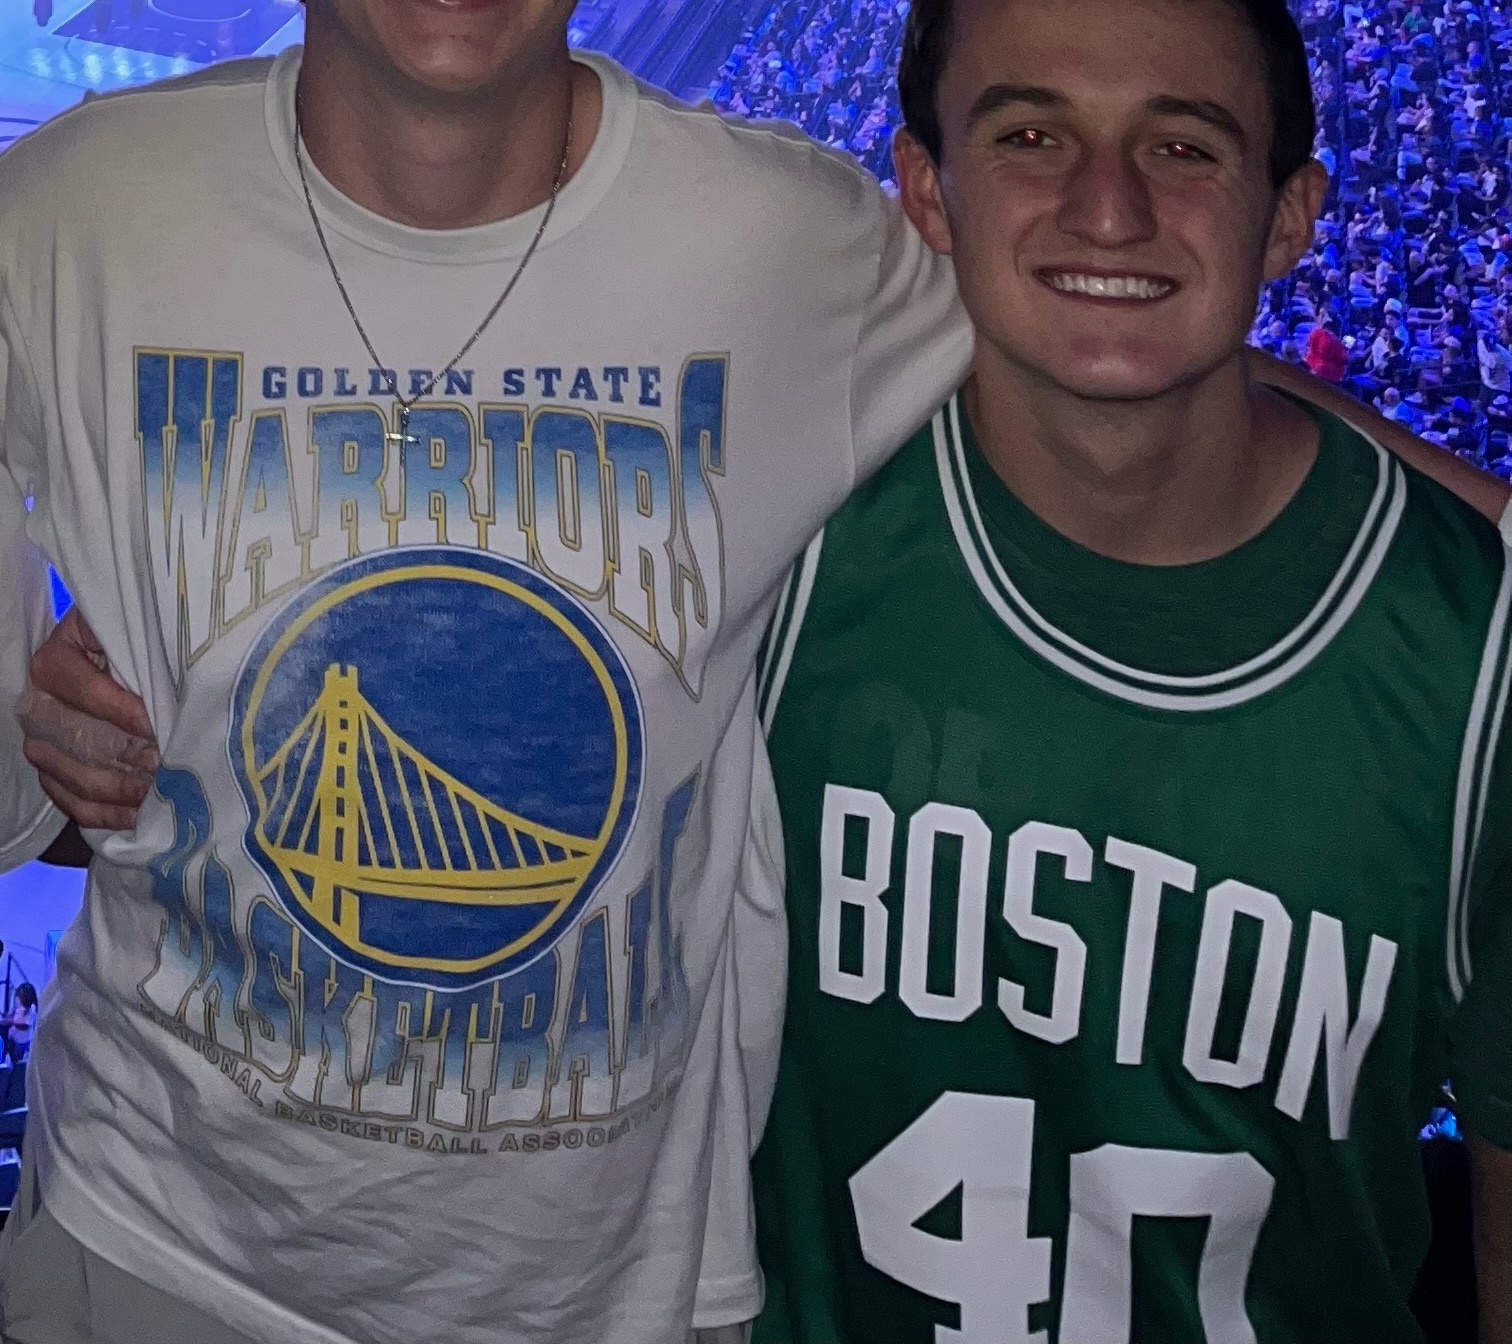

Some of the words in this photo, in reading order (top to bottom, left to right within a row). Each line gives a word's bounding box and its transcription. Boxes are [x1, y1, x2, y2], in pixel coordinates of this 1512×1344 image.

[132, 345, 731, 704] WARRIORS
[261, 365, 476, 401] GOLDEN
[502, 365, 663, 408] STATE
[817, 782, 1399, 1142] BOSTON
[847, 1089, 1276, 1344] 40
